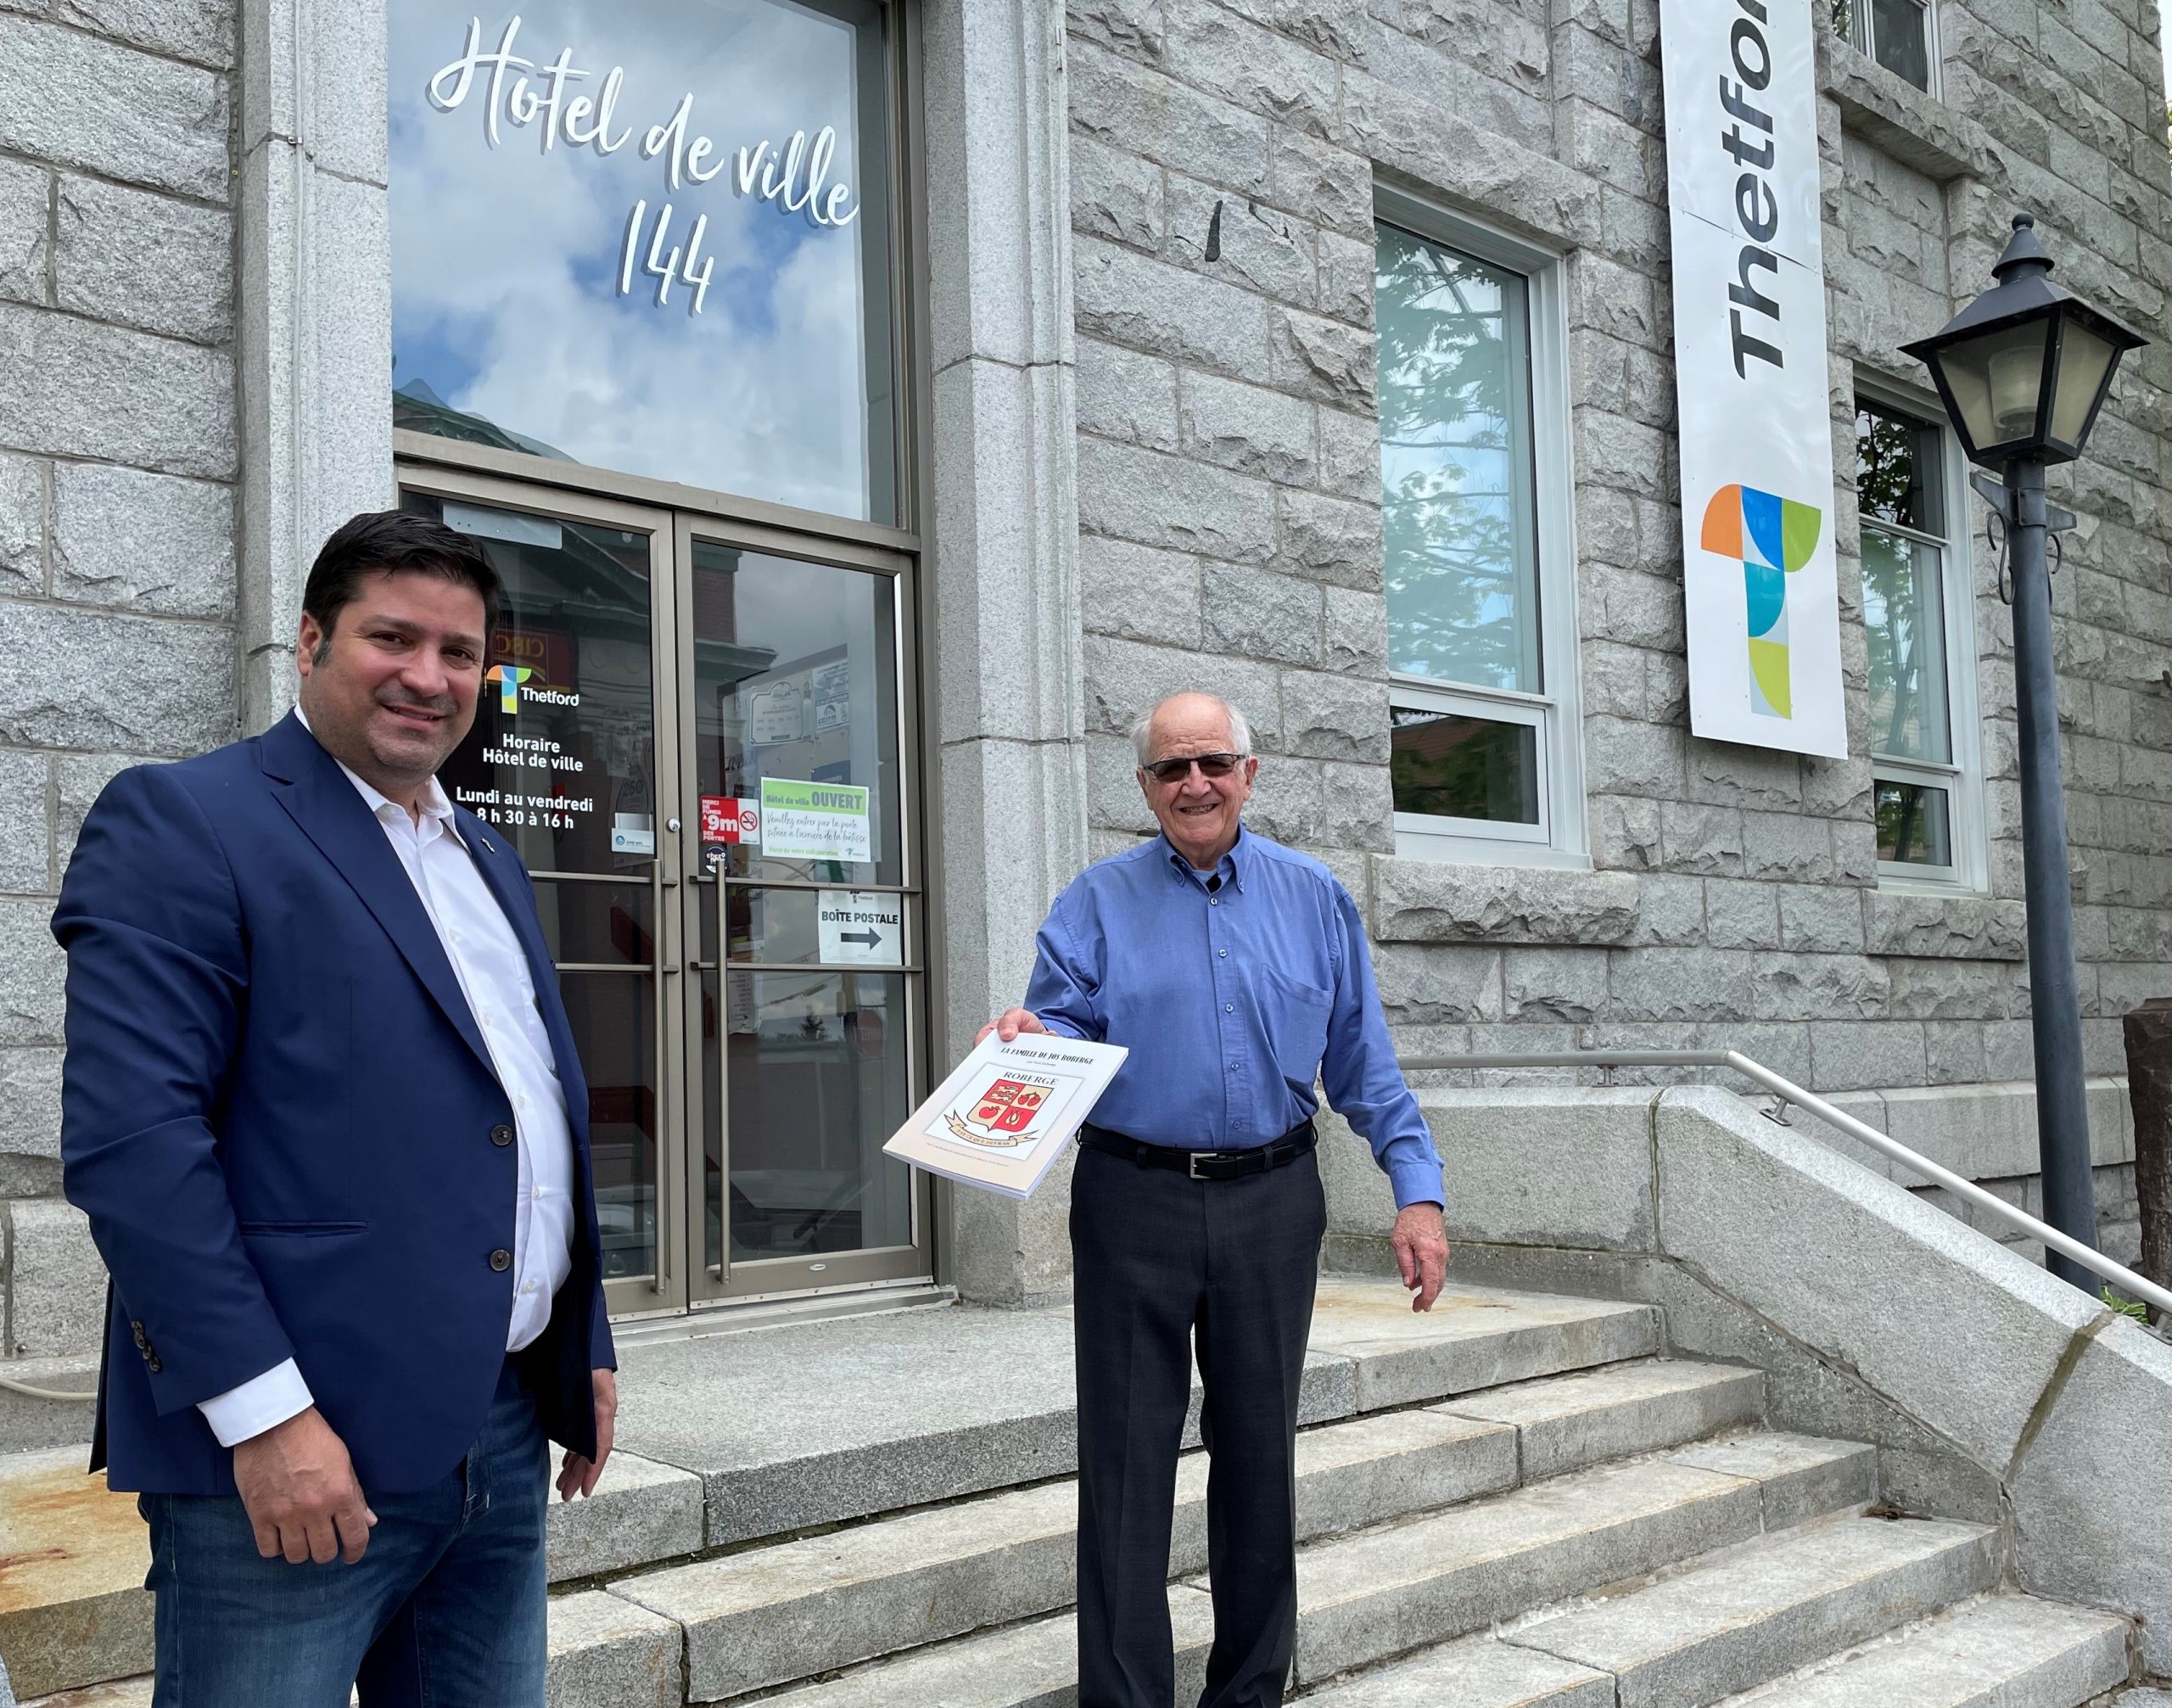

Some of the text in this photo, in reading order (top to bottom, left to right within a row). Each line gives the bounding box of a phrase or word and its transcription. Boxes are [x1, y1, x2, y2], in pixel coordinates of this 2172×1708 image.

[646, 92, 724, 189] de
[739, 125, 860, 226] ville
[621, 199, 714, 314] 144
[521, 686, 579, 707] Thetford
[502, 733, 561, 753] Horaire
[483, 748, 584, 772] Hôtel de ville
[456, 786, 593, 812] Lundi au vendredi
[786, 796, 794, 804] de
[795, 797, 809, 806] ville
[811, 791, 863, 809] OUVERT
[477, 808, 574, 829] 8 h 30 à 16 h
[708, 815, 738, 832] 9m
[821, 909, 898, 925] BOÎTE POSTALE
[1010, 1049, 1038, 1058] FAMILLE
[1061, 1054, 1094, 1065] ROBERGE
[1003, 1071, 1059, 1086] ROBERGE
